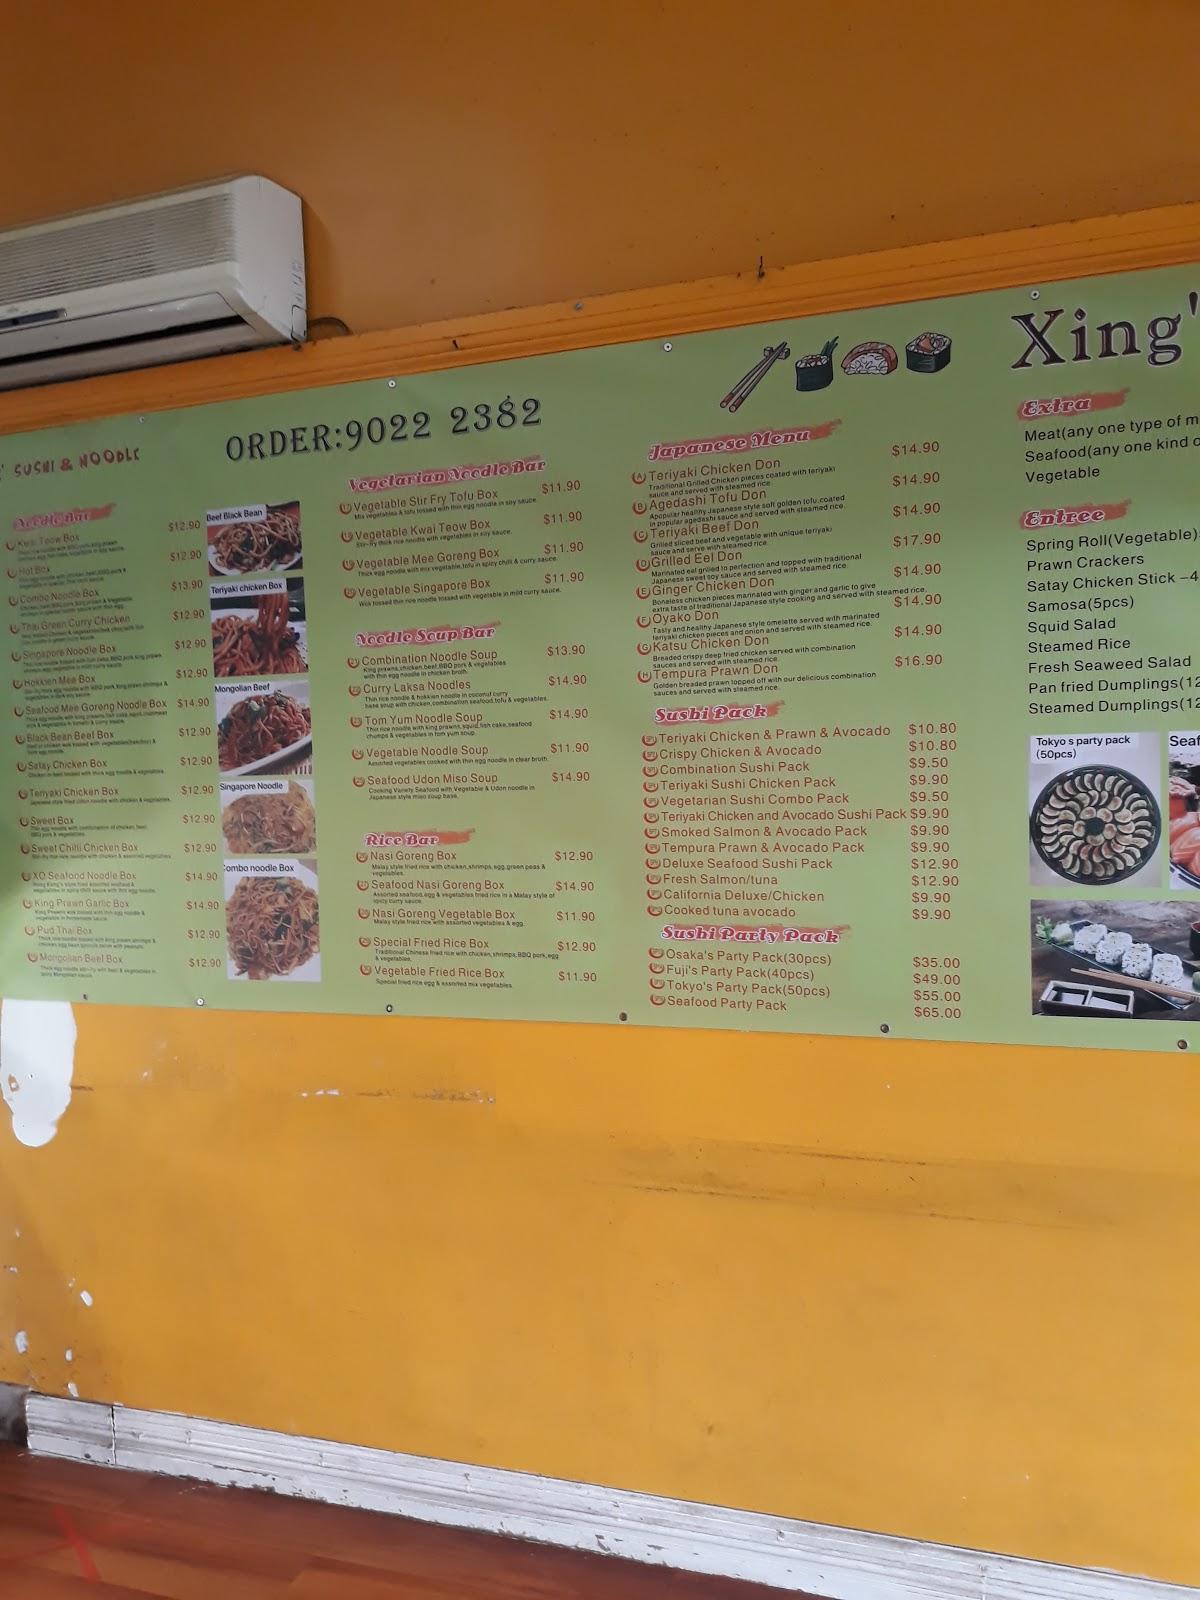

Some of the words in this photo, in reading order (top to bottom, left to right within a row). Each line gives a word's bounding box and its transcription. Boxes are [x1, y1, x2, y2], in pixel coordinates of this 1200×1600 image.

[1022, 397, 1092, 417] Extra
[225, 411, 431, 461] ORDER:9022
[450, 395, 542, 434] 2382
[1024, 426, 1094, 442] Meat(any
[1097, 423, 1126, 435] one
[1129, 419, 1162, 434] type
[1166, 415, 1181, 428] of
[648, 437, 746, 461] Japanese
[751, 429, 810, 447] Menu
[891, 440, 939, 457] $14.90
[1025, 444, 1120, 463] Seafood(any
[1123, 442, 1152, 453] one
[1156, 436, 1188, 450] kind
[60, 458, 73, 471] &
[648, 466, 697, 482] Teriyaki
[700, 462, 751, 476] Chicken
[755, 459, 780, 470] Don
[348, 472, 445, 492] Vegetarian
[448, 463, 509, 481] Noodle
[511, 459, 546, 474] Bar
[892, 471, 940, 488] $14.90
[1025, 465, 1100, 484] Vegetable
[649, 494, 706, 512] Agedashi
[709, 491, 738, 504] Tofu
[741, 489, 767, 501] Don
[543, 510, 582, 525] $11.90
[1024, 508, 1105, 528] Entree
[355, 527, 408, 541] Vegetable
[410, 525, 436, 535] Kwai
[438, 521, 467, 532] Teow
[469, 519, 491, 530] Box
[892, 532, 941, 548] $17.90
[1026, 539, 1074, 553] Spring
[650, 553, 691, 569] Grilled
[694, 551, 714, 564] Eel
[717, 550, 742, 562] Don
[1027, 560, 1072, 572] Prawn
[1076, 554, 1144, 568] Crackers
[1027, 580, 1069, 593] Satay
[1072, 575, 1133, 589] Chicken
[1138, 571, 1175, 585] Stick
[1027, 595, 1134, 613] Samosa(5pcs)
[1027, 619, 1069, 635] Squid
[1073, 617, 1116, 631] Salad
[356, 631, 412, 646] Noodle
[415, 628, 458, 644] Soup
[462, 626, 496, 640] Bar
[1028, 639, 1093, 654] Steamed
[1098, 638, 1131, 650] Rice
[1028, 660, 1069, 674] Fresh
[1074, 657, 1143, 672] Seaweed
[1147, 655, 1191, 669] Salad
[363, 683, 391, 695] Curry
[393, 682, 425, 693] Laksa
[428, 679, 471, 691] Noodles
[548, 674, 587, 687] $14.90
[1028, 682, 1056, 694] Pan
[1060, 680, 1093, 693] fried
[549, 708, 588, 720] $14.90
[654, 707, 709, 722] Sushi
[713, 704, 768, 719] Pack
[1028, 700, 1094, 714] Steamed
[364, 715, 387, 726] Tom
[389, 715, 413, 724] Yum
[415, 712, 453, 724] Noodle
[455, 712, 483, 725] Soup
[908, 739, 957, 752] $10.80
[1036, 737, 1066, 748] Tokyo
[1076, 737, 1103, 747] party
[1105, 735, 1131, 746] pack
[659, 748, 697, 761] Crispy
[700, 747, 750, 758] Chicken
[753, 745, 762, 757] &
[765, 744, 822, 756] Avocado
[1036, 749, 1077, 760] (50pcs)
[365, 833, 402, 847] Rice
[404, 832, 440, 847] Bar
[370, 851, 393, 861] Nasi
[395, 850, 434, 863] Goreng
[436, 850, 456, 861] Box
[554, 850, 593, 862] $12.90
[662, 857, 704, 869] Deluxe
[707, 857, 759, 869] Seafood
[762, 857, 797, 869] Sushi
[801, 858, 833, 869] Pack
[911, 858, 959, 870] $12.90
[662, 873, 697, 884] Fresh
[699, 873, 778, 885] Salmon/tuna
[911, 874, 959, 887] $12.90
[663, 888, 721, 900] California
[724, 889, 824, 902] Deluxe/Chicken
[911, 891, 951, 903] $9.90
[663, 904, 710, 916] Cooked
[712, 906, 739, 916] tuna
[743, 906, 796, 917] avocado
[911, 908, 951, 920] $9.90
[661, 925, 715, 940] Sushi
[719, 927, 779, 944] Party
[783, 928, 840, 943] Pack
[665, 948, 714, 961] Osaka's
[717, 950, 749, 964] Party
[752, 951, 832, 967] Pack(30pcs)
[912, 956, 960, 969] $35.00
[666, 964, 698, 977] Fuji's
[701, 965, 733, 979] Party
[736, 966, 814, 982] Pack(40pcs)
[912, 972, 961, 985] $49.00
